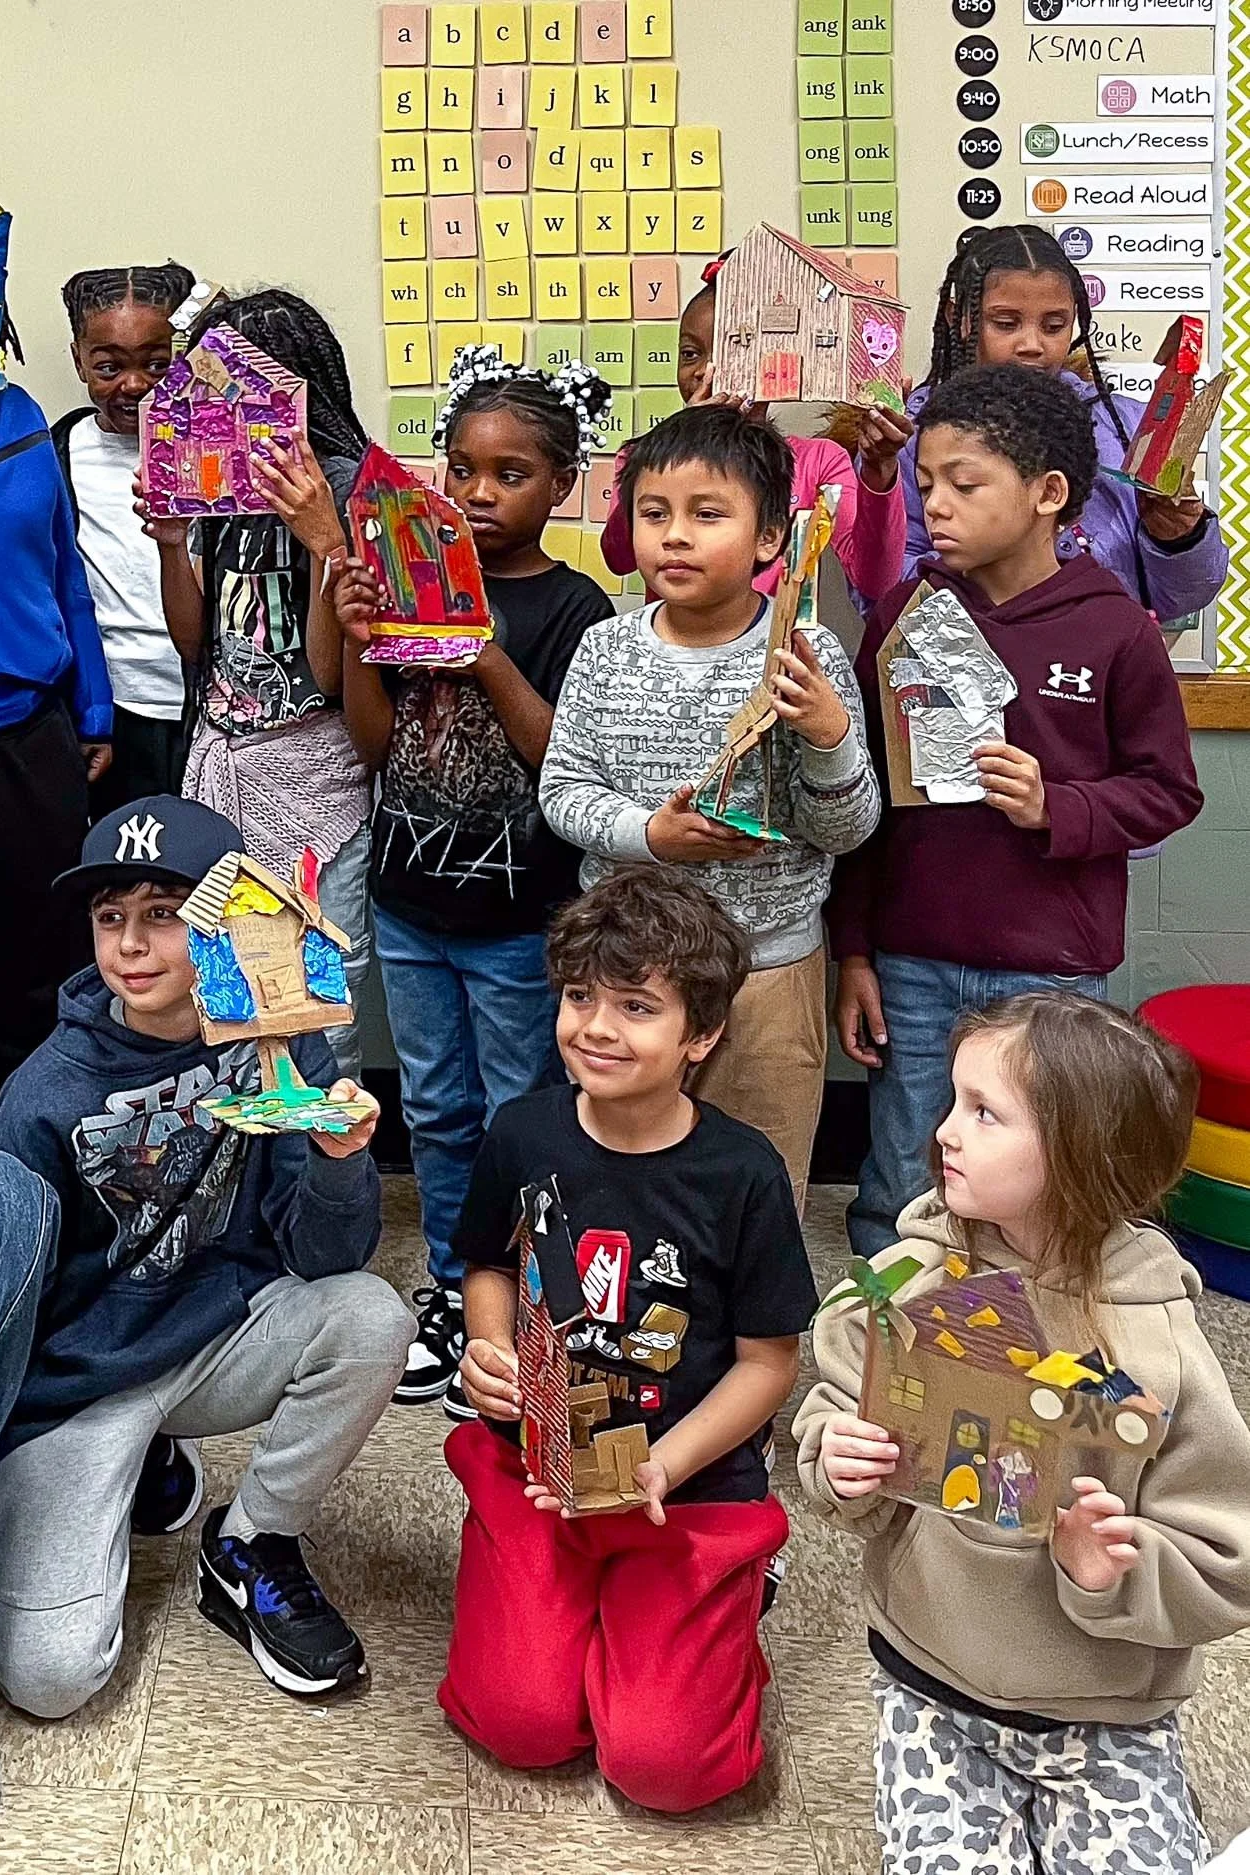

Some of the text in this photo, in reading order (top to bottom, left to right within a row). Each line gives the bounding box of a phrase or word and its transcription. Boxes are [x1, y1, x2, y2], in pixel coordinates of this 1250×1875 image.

[958, 0, 991, 13] 8:50
[1066, 0, 1139, 11] Morning
[646, 16, 655, 34] f
[805, 21, 838, 37] ang
[852, 15, 886, 30] ank
[398, 28, 411, 42] a
[446, 24, 460, 43] b
[497, 27, 509, 40] c
[546, 21, 560, 40] d
[598, 25, 610, 39] e
[959, 47, 996, 62] 9:00
[1029, 34, 1144, 63] KSMOCA
[595, 85, 610, 103] k
[651, 84, 656, 103] l
[807, 82, 835, 99] ing
[854, 80, 884, 94] ink
[1152, 86, 1210, 103] Math
[398, 91, 411, 113] g
[443, 88, 458, 107] h
[498, 89, 503, 105] i
[545, 89, 555, 111] j
[962, 90, 997, 105] 9:40
[961, 139, 1000, 153] 10:50
[1064, 133, 1208, 149] Lunch/Recess
[691, 151, 703, 165] s
[806, 147, 839, 163] ong
[855, 144, 889, 158] onk
[392, 158, 415, 172] m
[443, 158, 458, 171] n
[498, 155, 511, 169] o
[591, 158, 613, 172] qu
[643, 153, 653, 166] r
[965, 189, 995, 203] 11:25
[1075, 184, 1206, 204] Read Aloud
[597, 216, 611, 230] x
[693, 216, 704, 230] z
[807, 208, 840, 223] unk
[858, 211, 892, 227] ung
[400, 218, 408, 235] t
[446, 221, 461, 234] u
[496, 223, 509, 236] v
[544, 218, 564, 231] w
[646, 216, 659, 235] y
[1109, 234, 1203, 257] Reading
[391, 286, 418, 300] wh
[445, 283, 466, 297] ch
[497, 282, 518, 296] sh
[550, 282, 566, 297] th
[598, 282, 619, 296] ck
[648, 283, 662, 302] y
[1121, 283, 1203, 299] Recess
[405, 343, 414, 362] f
[547, 349, 570, 365] all
[595, 352, 623, 362] am
[648, 352, 670, 362] an
[398, 420, 426, 433] old
